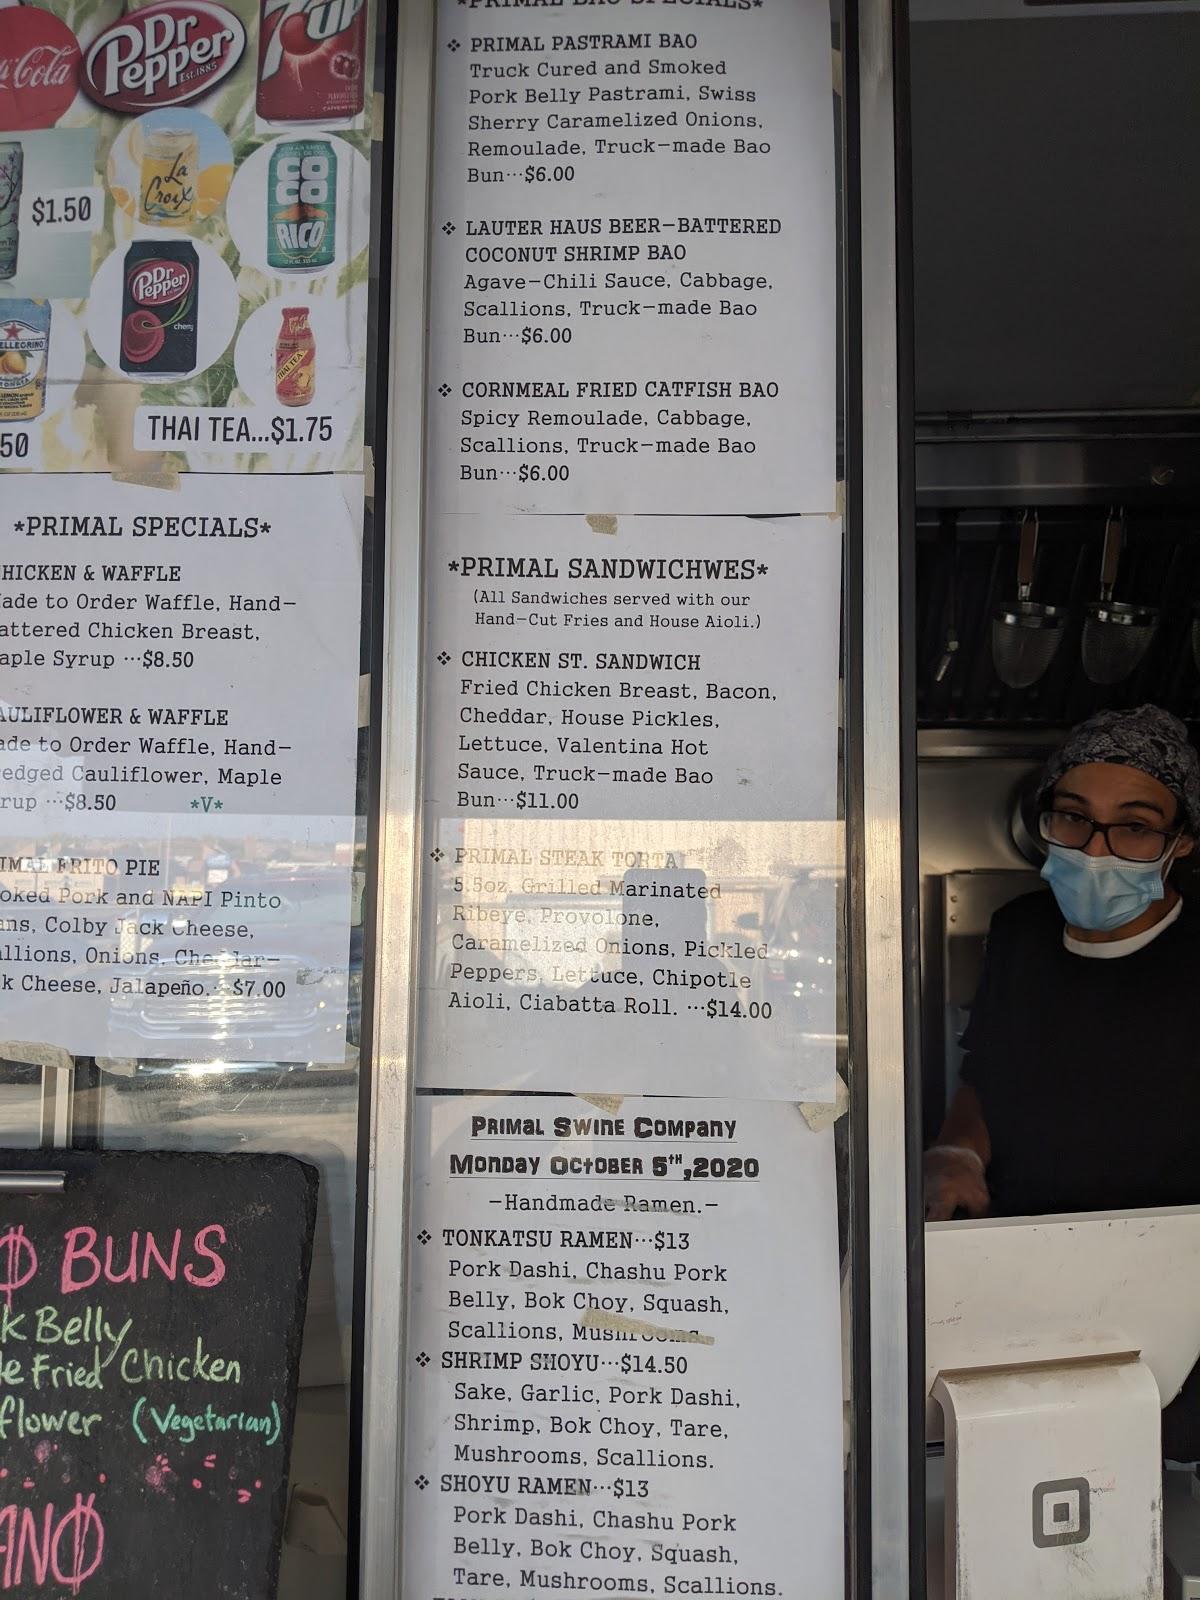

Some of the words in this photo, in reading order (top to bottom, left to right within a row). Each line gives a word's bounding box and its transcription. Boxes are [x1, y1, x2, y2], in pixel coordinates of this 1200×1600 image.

[146, 12, 198, 54] Dr
[471, 37, 544, 52] PRIMAL
[552, 34, 651, 50] PASTRAMI
[659, 34, 697, 48] BAO
[86, 28, 233, 95] Pepper
[470, 63, 529, 78] Truck
[537, 61, 597, 77] Cured
[605, 60, 640, 75] and
[649, 59, 727, 75] Smoked
[469, 89, 517, 104] Pork
[525, 88, 581, 104] Belly
[589, 85, 690, 101] Pastrami,
[699, 86, 755, 102] Swiss
[469, 116, 540, 131] Sherry
[547, 112, 678, 129] Caramelized
[686, 112, 762, 128] Onions,
[468, 140, 585, 156] Remoulade,
[734, 139, 770, 153] Bao
[164, 152, 188, 184] La
[144, 174, 192, 210] Croix
[31, 195, 91, 226] $1.50
[277, 220, 324, 250] RICO
[466, 220, 543, 235] LAUTER
[550, 219, 601, 235] HAUS
[609, 218, 781, 234] BEER-BATTERED
[466, 247, 557, 262] COCONUT
[564, 246, 639, 262] SHRIMP
[648, 244, 686, 260] BAO
[133, 272, 187, 298] Pepper
[152, 266, 174, 292] Dr
[464, 273, 597, 291] Agave-Chili
[605, 273, 670, 288] Sauce,
[680, 272, 772, 290] Cabbage,
[464, 301, 570, 317] Scallions,
[720, 300, 757, 315] Bao
[288, 351, 304, 366] TEA
[463, 382, 569, 397] CORNMEAL
[577, 382, 637, 397] FRIED
[645, 381, 732, 397] CATFISH
[739, 382, 778, 397] BAO
[148, 415, 199, 441] THAI
[462, 410, 520, 427] Spicy
[528, 410, 647, 426] Remoulade,
[658, 409, 750, 428] Cabbage,
[84, 565, 95, 581] &
[102, 565, 181, 581] WAFFLE
[46, 594, 68, 609] to
[77, 593, 137, 609] Order
[145, 594, 220, 612] Waffle,
[474, 589, 505, 603] (All
[512, 591, 607, 605] Sandwiches
[614, 593, 670, 605] served
[677, 593, 714, 605] with
[721, 596, 750, 606] our
[475, 612, 557, 626] Hand-Cut
[564, 614, 608, 626] Fries
[615, 615, 643, 627] and
[650, 615, 699, 628] House
[705, 614, 760, 629] Aioli.)
[89, 622, 173, 638] Chicken
[182, 624, 259, 641] Breast,
[53, 650, 114, 669] Syrup
[462, 651, 550, 668] CHICKEN
[558, 653, 587, 669] ST.
[596, 653, 700, 670] SANDWICH
[461, 680, 518, 695] Fried
[527, 681, 611, 697] Chicken
[619, 682, 697, 700] Breast,
[706, 683, 776, 701] Bacon,
[130, 708, 141, 724] &
[148, 709, 228, 725] WAFFLE
[461, 707, 552, 726] Cheddar,
[561, 710, 624, 725] House
[632, 710, 718, 728] Pickles,
[459, 735, 547, 753] Lettuce,
[557, 737, 663, 754] Valentina
[671, 739, 708, 755] Hot
[72, 766, 208, 785] Cauliflower,
[218, 768, 281, 787] Maple
[458, 763, 524, 781] Sauce,
[675, 768, 713, 784] Bao
[455, 849, 532, 865] PRIMAL
[540, 851, 604, 867] STEAK
[57, 858, 118, 879] FRITO
[125, 859, 160, 876] PIE
[59, 885, 109, 904] Pork
[116, 893, 154, 905] and
[162, 890, 212, 907] NAPI
[221, 891, 281, 908] Pinto
[522, 880, 601, 896] Grilled
[610, 881, 721, 899] Marinated
[46, 916, 107, 936] Colby
[115, 919, 164, 936] Jack
[452, 935, 587, 953] Caramelized
[684, 942, 769, 960] Pickled
[22, 976, 102, 994] Cheese,
[653, 969, 751, 989] Chipotle
[448, 992, 510, 1011] Aioli,
[520, 994, 616, 1013] Ciabatta
[624, 998, 677, 1015] Roll.
[443, 1229, 552, 1247] TONKATSU
[61, 1224, 227, 1294] BUNS
[449, 1260, 501, 1277] Pork
[509, 1261, 576, 1279] Dashi,
[587, 1262, 666, 1280] Chashu
[674, 1264, 727, 1281] Pork
[449, 1291, 515, 1310] Belly,
[525, 1292, 565, 1308] Bok
[574, 1292, 633, 1313] Choy,
[644, 1294, 728, 1314] Squash,
[36, 1306, 133, 1367] Belly
[449, 1321, 562, 1341] Scallions,
[32, 1346, 103, 1390] Fried
[121, 1336, 241, 1383] Chicken
[442, 1351, 522, 1369] SHRIMP
[455, 1383, 511, 1402] Sake,
[521, 1384, 599, 1404] Garlic,
[609, 1386, 662, 1404] Pork
[671, 1388, 739, 1408] Dashi,
[455, 1414, 540, 1435] Shrimp,
[550, 1416, 591, 1433] Bok
[600, 1417, 660, 1438] Choy,
[671, 1419, 727, 1439] Tare,
[454, 1444, 587, 1466] Mushrooms,
[597, 1448, 713, 1468] Scallions.
[441, 1474, 510, 1493] SHOYU
